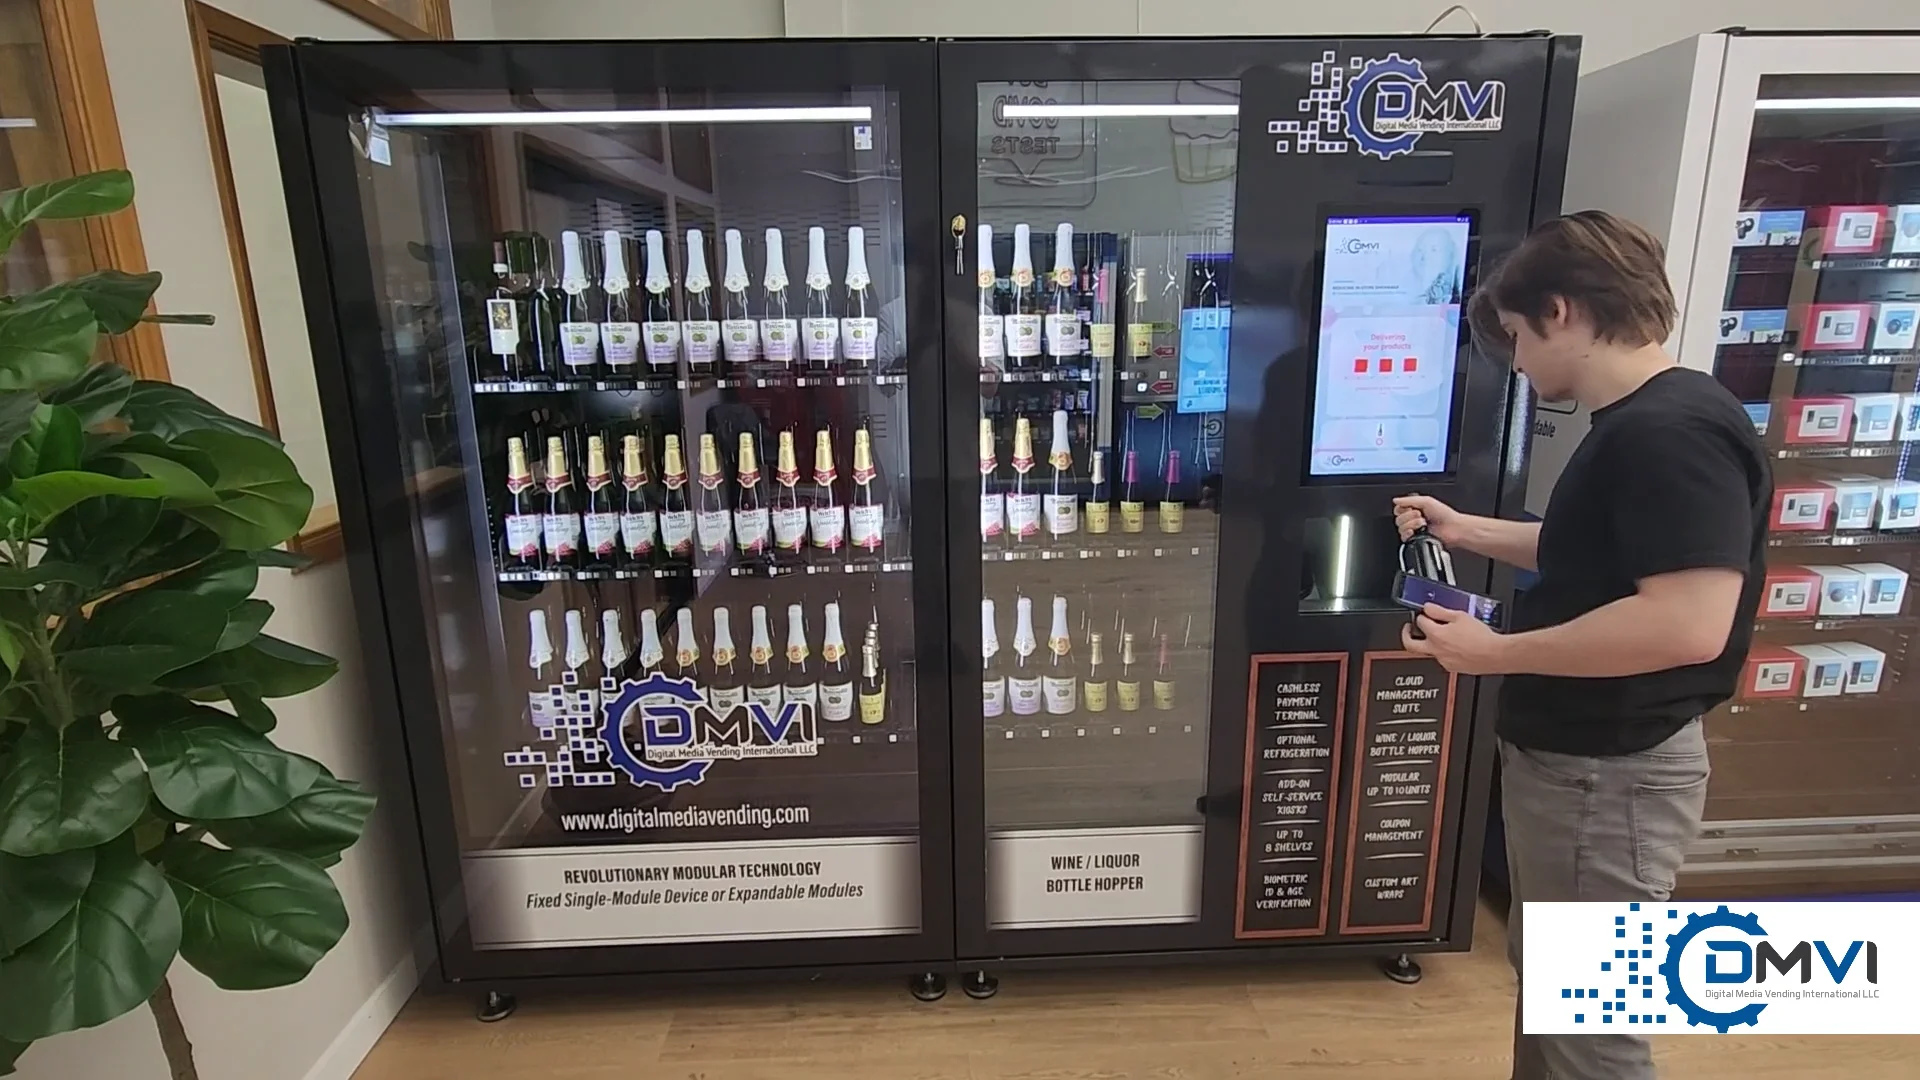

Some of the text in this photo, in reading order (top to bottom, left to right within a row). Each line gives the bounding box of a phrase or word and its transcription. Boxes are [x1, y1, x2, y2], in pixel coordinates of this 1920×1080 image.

[1375, 81, 1505, 120] DMVI
[1375, 120, 1500, 131] Digital Media Vending International LLC
[1354, 242, 1380, 250] DMVI
[1370, 333, 1406, 343] Delivering
[1381, 342, 1412, 351] products
[1395, 676, 1424, 686] CLOUD
[1277, 683, 1321, 693] CASHLESS
[1376, 688, 1439, 700] MANAGEMENT
[1277, 697, 1319, 707] PAYMENT
[1392, 703, 1420, 713] SUITE
[1274, 711, 1320, 720] TERMINAL
[644, 703, 814, 747] DMVI
[1276, 735, 1317, 745] OPTIONAL
[1375, 733, 1398, 743] WINE
[1407, 732, 1437, 742] LIQUOR
[648, 744, 816, 761] Digital Media Vending International LLC
[1263, 748, 1330, 759] REFRIGERATION
[1370, 745, 1440, 757] BOTTLE HOPPER
[1380, 772, 1420, 782] MODULAR
[1278, 779, 1310, 789] ADD-ON
[1367, 787, 1379, 796] UP
[1382, 786, 1394, 795] TO
[1262, 792, 1324, 803] SELF-SERVICE
[1276, 805, 1308, 815] KIOSKS
[561, 806, 810, 833] www.digitalmediavending.com
[1380, 819, 1411, 829] COUPON
[1276, 829, 1303, 839] UP TO
[1364, 830, 1424, 842] MANAGEMENT
[1265, 842, 1313, 853] 8 SHELVES
[1051, 854, 1140, 870] WINE / LIQUOR
[564, 861, 822, 885] REVOLUTIONARY MODULAR TECHNOLOGY
[1046, 876, 1144, 893] BOTTLE HOPPER
[1264, 874, 1308, 885] BIOMETRIC
[1365, 876, 1419, 887] CUSTOM ART
[526, 882, 864, 910] Fixed Single-Module Device or Expandable Modules
[1265, 886, 1304, 897] ID & AGE
[1377, 890, 1404, 900] WRAPS
[1256, 898, 1312, 909] VERIFICATION
